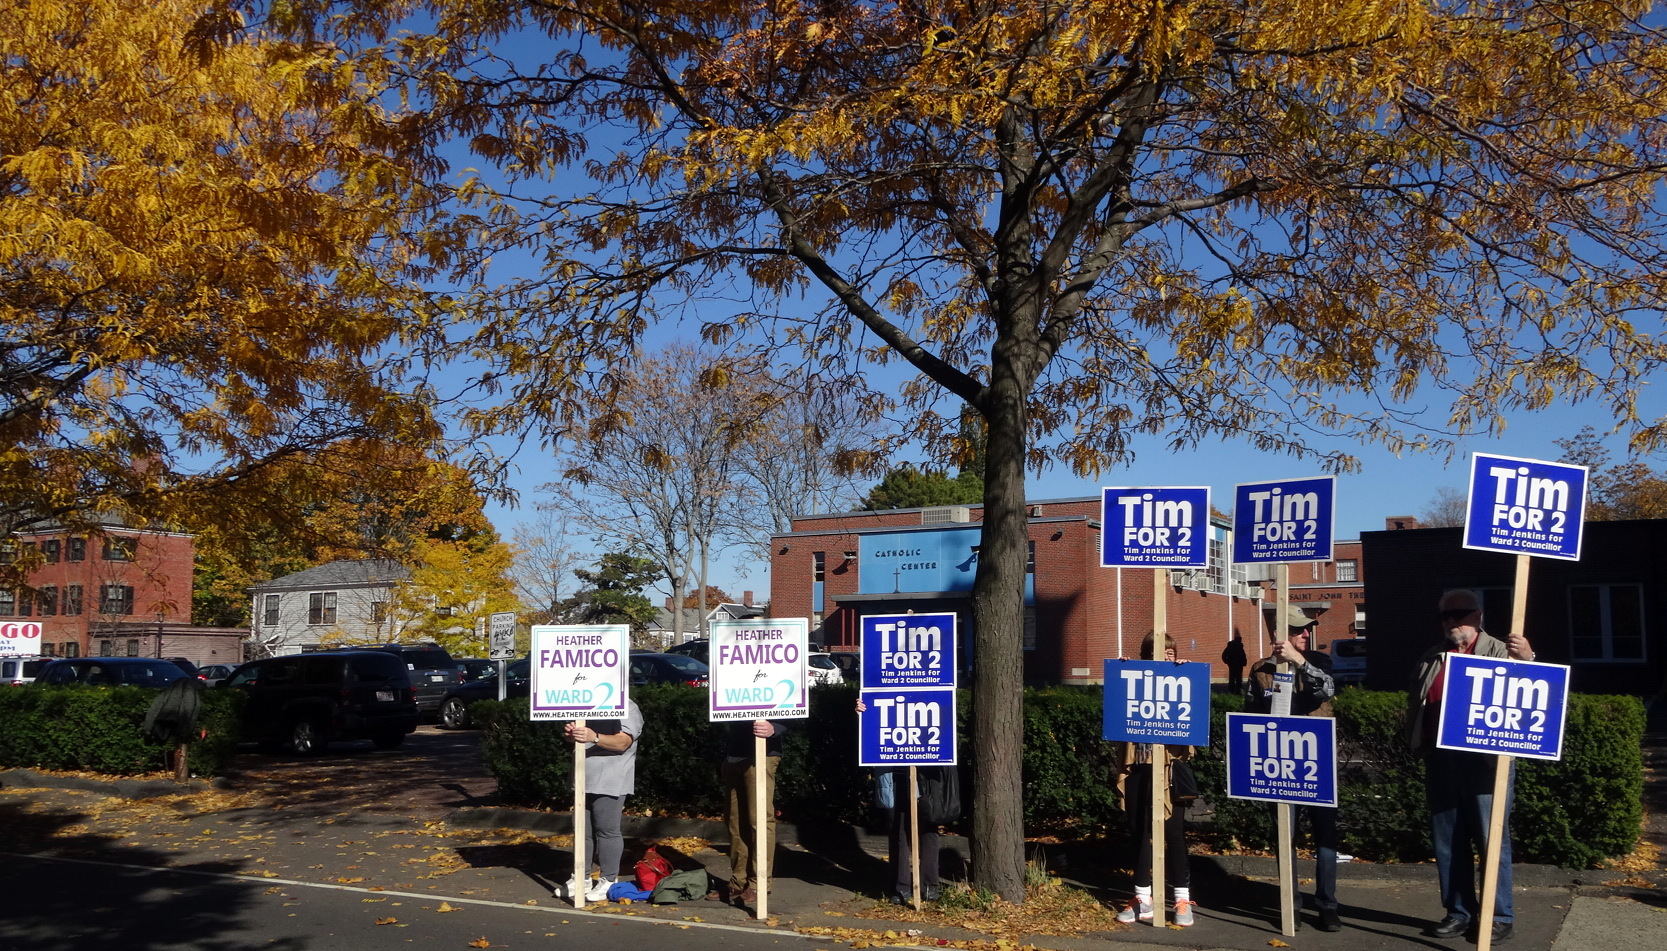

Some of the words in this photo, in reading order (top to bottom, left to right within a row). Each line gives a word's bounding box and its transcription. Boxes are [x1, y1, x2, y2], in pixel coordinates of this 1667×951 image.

[1490, 467, 1568, 511] Tim
[1118, 494, 1192, 527] Tim
[1249, 488, 1318, 522] Tim
[1492, 504, 1544, 531] FOR
[1551, 511, 1566, 533] 2
[1124, 527, 1170, 546] FOR
[1178, 528, 1191, 546] 2
[1253, 522, 1296, 542] FOR
[1304, 520, 1317, 539] 2
[1492, 528, 1508, 536] Tim
[1511, 530, 1546, 540] Jenkins
[875, 549, 921, 558] CATHOLIC
[1491, 537, 1512, 545] Ward
[1522, 540, 1562, 551] Councillor
[901, 562, 937, 570] CENTER
[1, 623, 40, 638] GO
[736, 630, 783, 640] HEATHER
[875, 621, 940, 651] Tim
[557, 636, 602, 645] HEATHER
[541, 649, 618, 668] FAMICO
[720, 644, 798, 665] FAMICO
[881, 652, 922, 669] FOR
[929, 651, 940, 668] 2
[573, 673, 587, 685] for
[753, 669, 768, 682] for
[545, 690, 593, 704] WARD
[594, 682, 613, 709] 2
[725, 687, 774, 703] WARD
[775, 679, 794, 708] 2
[1121, 670, 1190, 702] Tim
[1465, 666, 1549, 710] Tim
[713, 710, 806, 719] WWW.HEATHERFAMICO.COM
[874, 696, 940, 727] Tim
[1126, 700, 1170, 720] FOR
[1178, 703, 1191, 721] 2
[1468, 704, 1522, 730] FOR
[1529, 711, 1546, 732] 2
[880, 728, 921, 745] FOR
[928, 727, 940, 744] 2
[1153, 729, 1190, 737] Councillor
[1242, 722, 1318, 760] Tim
[1488, 730, 1524, 740] Jenkins
[1466, 736, 1488, 745] Ward
[1498, 740, 1541, 750] Councillor
[1250, 757, 1296, 779] FOR
[1304, 761, 1318, 781] 2
[1268, 780, 1300, 788] Jenkins
[1279, 789, 1317, 797] Councillor
